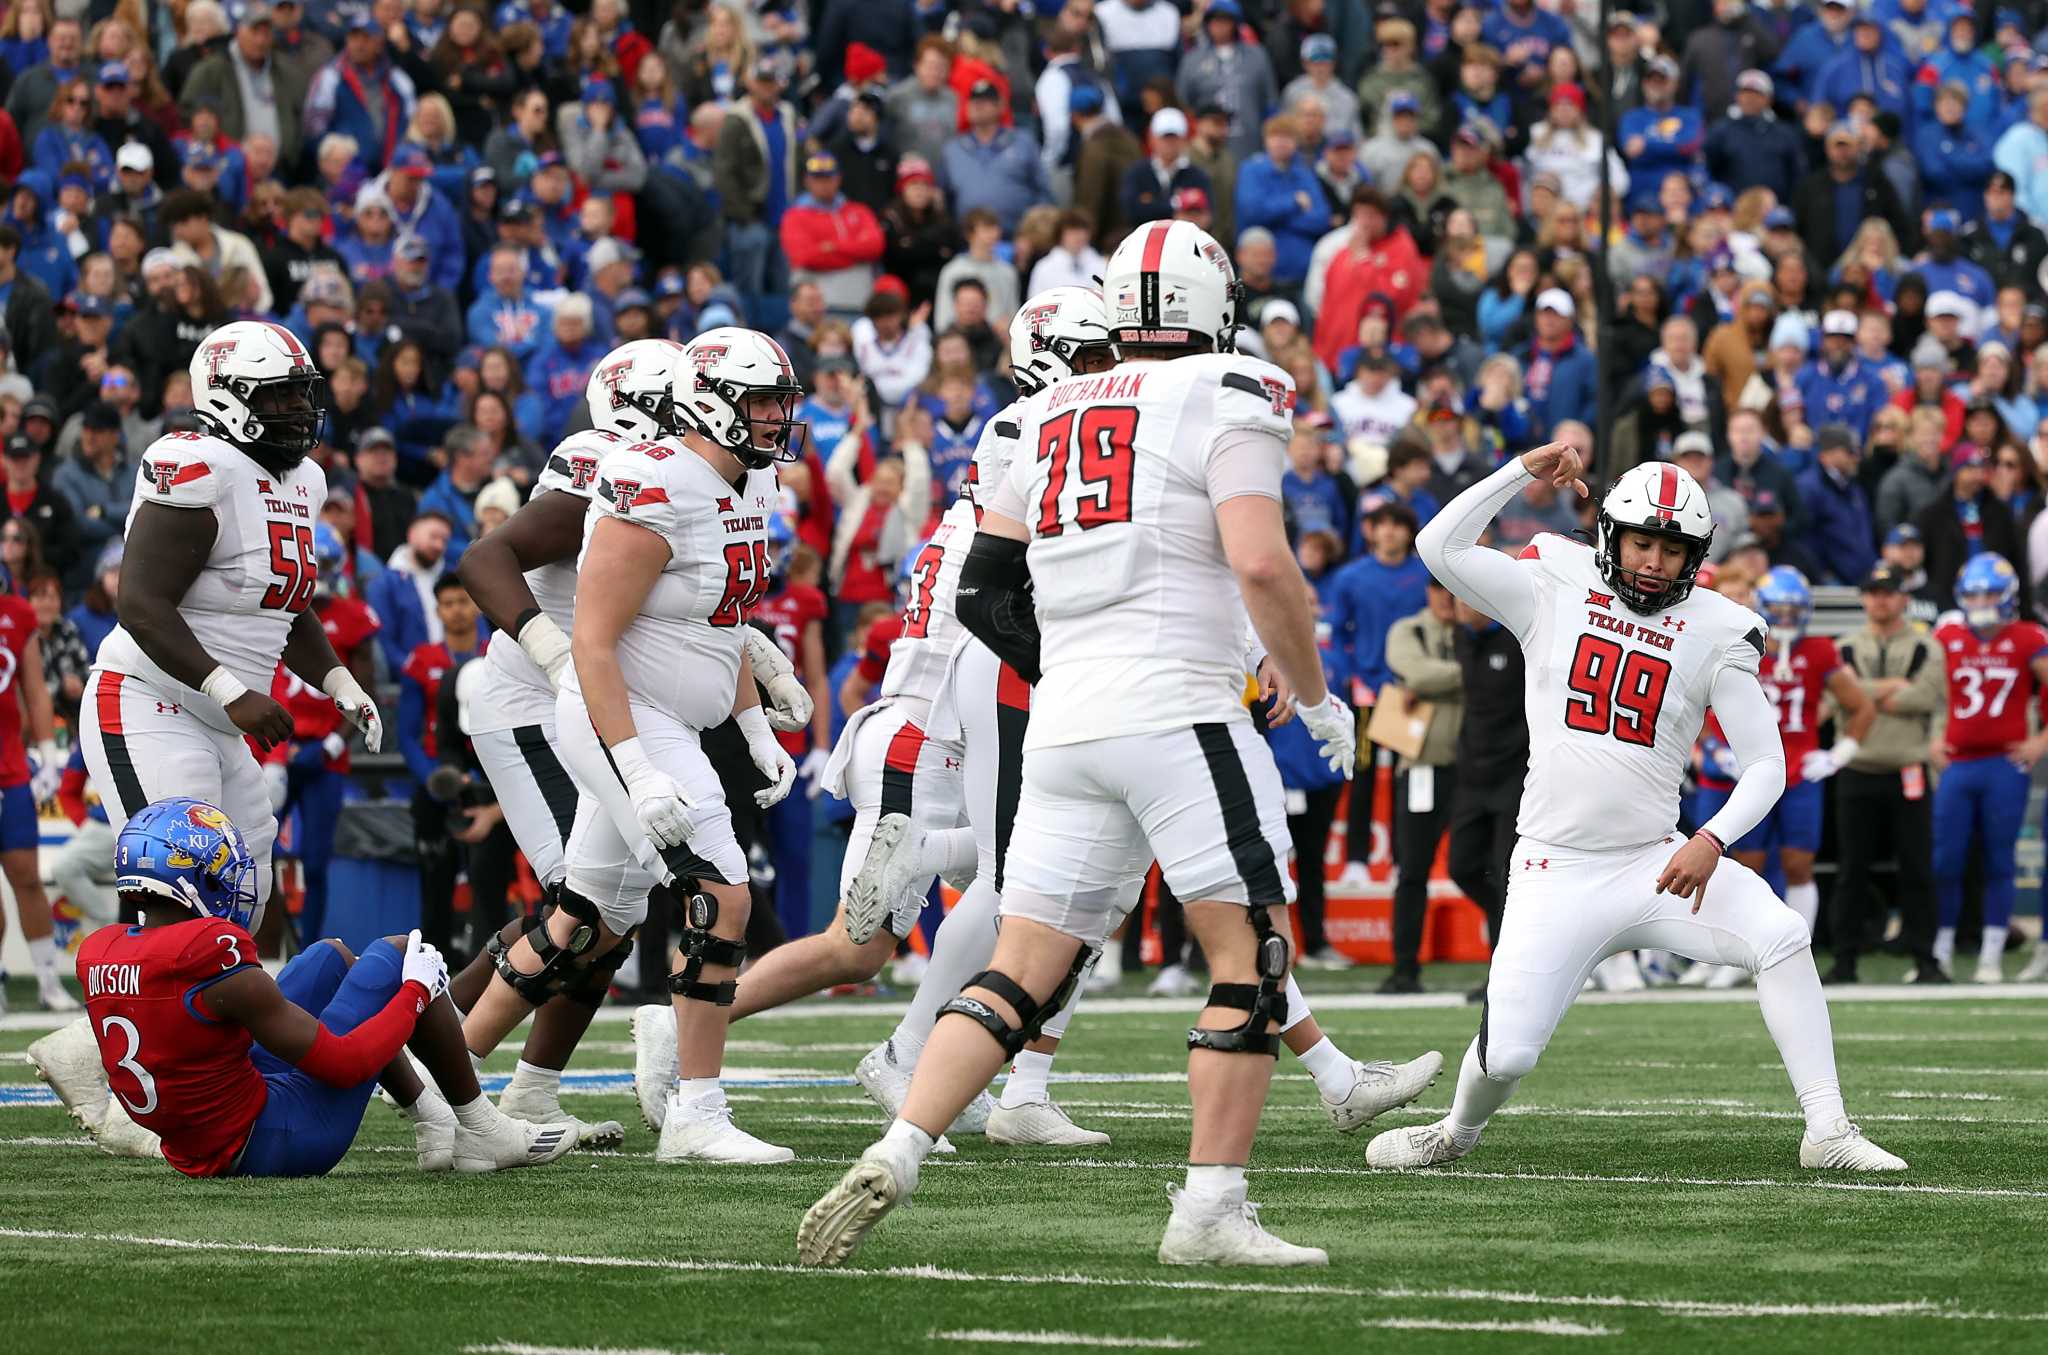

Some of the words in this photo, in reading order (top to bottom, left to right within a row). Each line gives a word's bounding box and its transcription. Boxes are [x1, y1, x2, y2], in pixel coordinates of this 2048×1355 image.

[1046, 371, 1148, 412] BUCHANAN
[1036, 405, 1140, 538] 79
[259, 520, 318, 613] 56
[708, 540, 771, 627] 66
[1588, 611, 1635, 637] TEXAS
[1637, 626, 1675, 651] TECH
[1565, 632, 1672, 748] 99
[1953, 667, 2019, 720] 37
[121, 846, 128, 865] 3
[189, 834, 209, 848] KU
[216, 934, 242, 971] 3
[88, 964, 141, 996] DOTSON
[102, 1015, 158, 1115] 3
